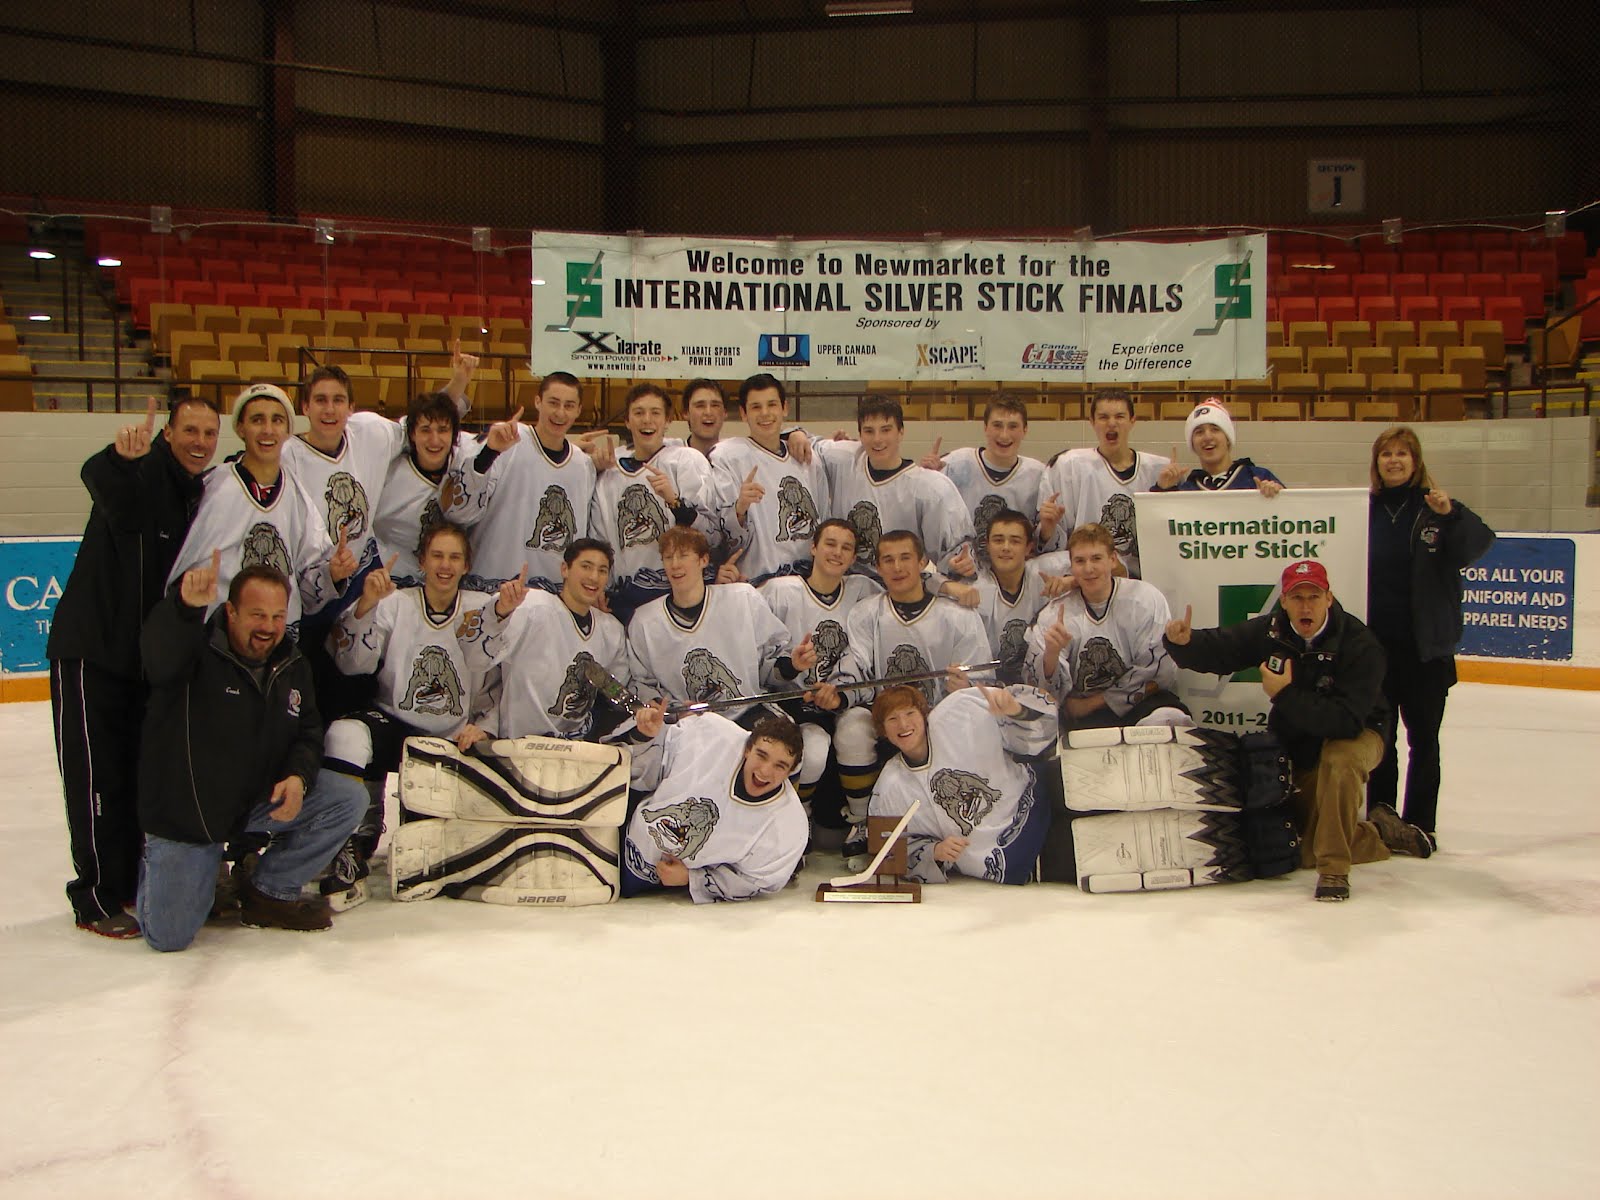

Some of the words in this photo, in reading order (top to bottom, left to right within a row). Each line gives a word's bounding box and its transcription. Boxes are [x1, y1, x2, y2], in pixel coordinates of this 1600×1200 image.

[686, 249, 804, 276] Welcome
[816, 252, 843, 276] to
[855, 252, 1006, 276] Newmarket
[1018, 254, 1056, 277] for
[1068, 254, 1110, 277] the
[614, 278, 851, 312] INTERNATIONAL
[864, 282, 964, 313] SILVER
[977, 281, 1064, 313] STICK
[1079, 283, 1183, 314] FINALS
[855, 317, 921, 330] Sponsored
[924, 317, 940, 330] by
[681, 346, 712, 355] XILARATE
[714, 346, 741, 356] SPORTS
[817, 344, 842, 355] UPPER
[845, 344, 877, 355] CANADA
[916, 344, 978, 366] XSCAPE
[1111, 342, 1184, 357] Experience
[689, 356, 711, 366] POWER
[714, 356, 733, 366] FLUID
[836, 355, 857, 366] MALL
[1098, 359, 1119, 371] the
[1124, 357, 1192, 370] Difference
[1168, 516, 1335, 536] International
[1178, 541, 1248, 560] Silver
[1491, 568, 1517, 582] ALL
[1520, 569, 1564, 583] YOUR
[6, 575, 64, 611] CA
[1530, 591, 1566, 607] AND
[1463, 612, 1516, 627] PPAREL
[1518, 614, 1567, 630] NEEDS
[1202, 710, 1268, 726] 2011-2
[525, 742, 573, 752] BAUER
[517, 895, 567, 903] BAUER
